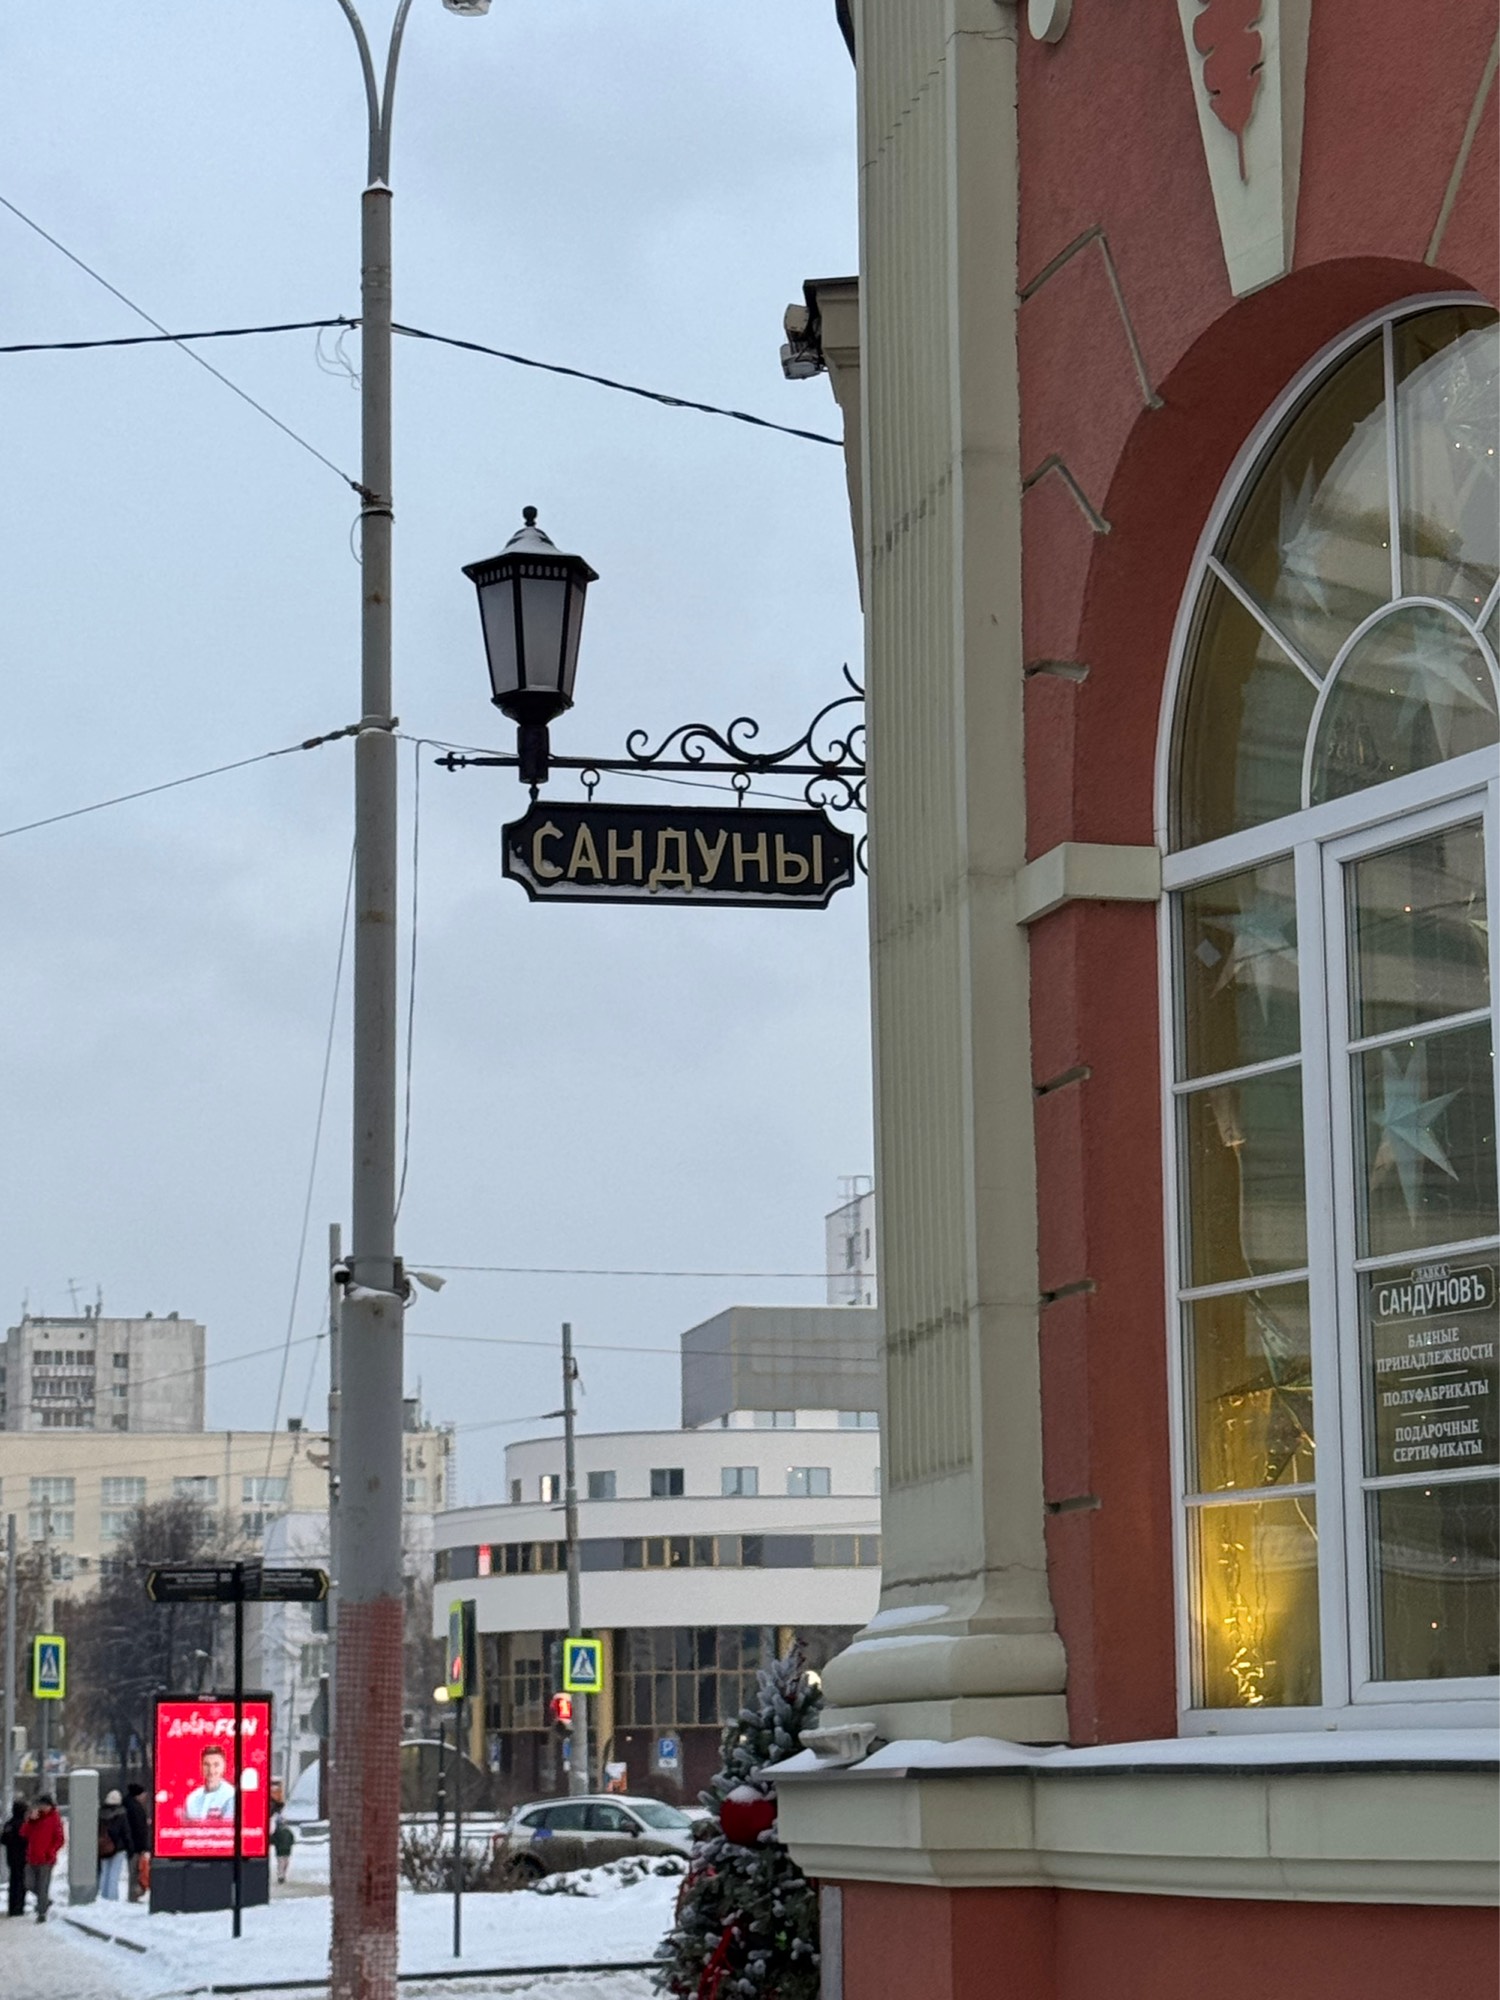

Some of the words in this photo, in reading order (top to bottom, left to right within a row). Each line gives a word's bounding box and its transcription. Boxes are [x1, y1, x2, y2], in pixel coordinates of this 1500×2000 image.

[532, 821, 824, 893] САНДУНЫ
[1379, 1275, 1486, 1316] САНДУНОВЪ
[1408, 1327, 1460, 1348] БАННЫЕ
[1376, 1343, 1494, 1373] ПРИНАДЛЕЖНОСТИ
[1383, 1379, 1489, 1407] ПОЛУФАБРИКАТЫ
[1395, 1418, 1480, 1443] ПОДАРОЧНЫЕ
[1393, 1439, 1483, 1463] СЕРТИФИКАТЫ
